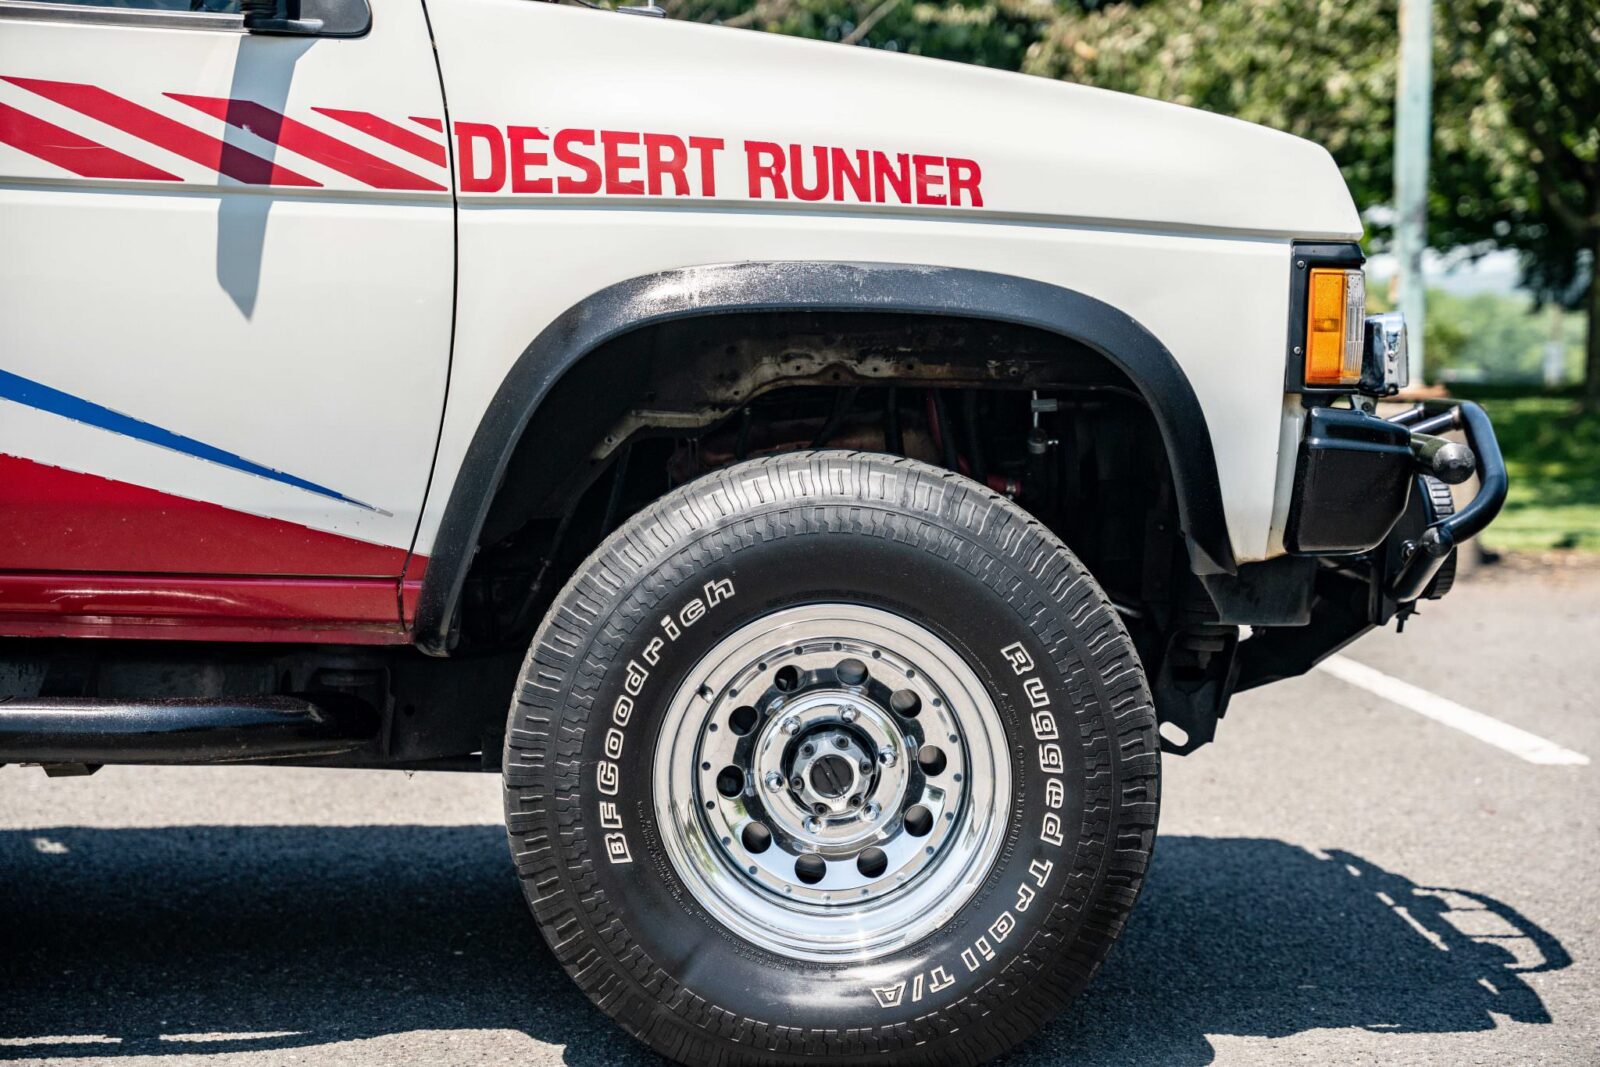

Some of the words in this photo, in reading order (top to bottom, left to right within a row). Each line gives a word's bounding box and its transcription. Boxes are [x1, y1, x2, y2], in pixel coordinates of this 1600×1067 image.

[453, 121, 725, 197] DESERT
[744, 140, 984, 208] RUNNER
[596, 577, 736, 864] BFGoodrich
[1000, 641, 1065, 848] Rugged
[960, 858, 1054, 973] Trail
[871, 965, 956, 1009] T/A
